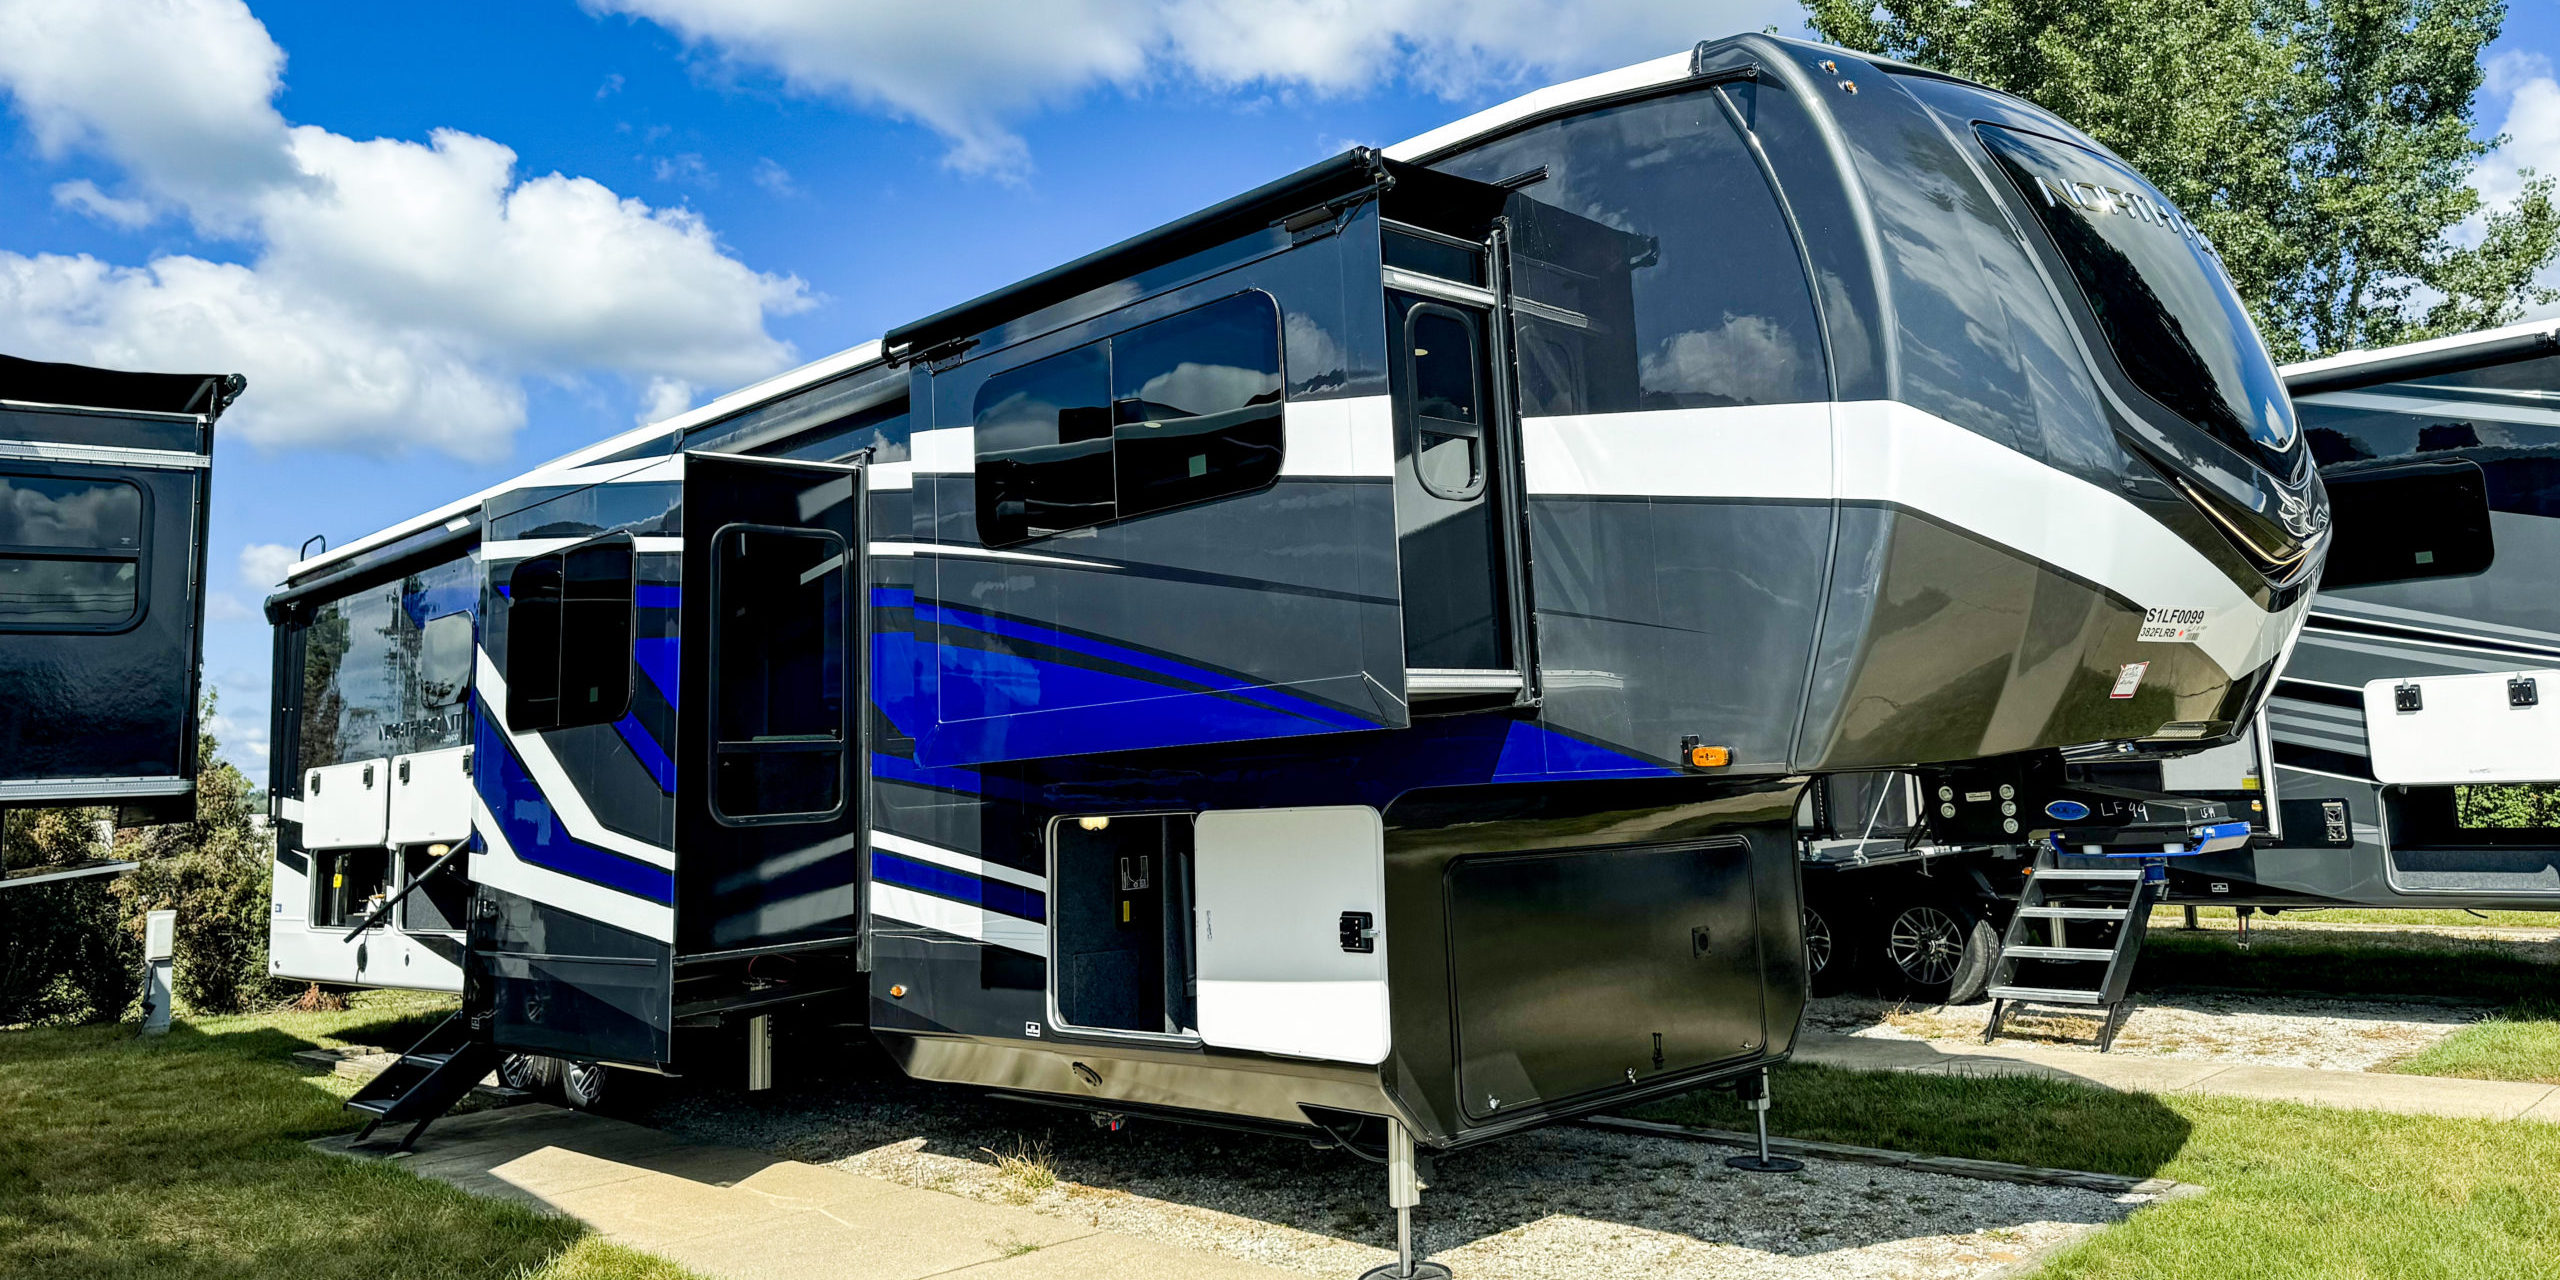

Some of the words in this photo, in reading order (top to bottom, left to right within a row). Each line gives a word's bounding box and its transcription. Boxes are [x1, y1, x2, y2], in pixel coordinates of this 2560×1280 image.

[2146, 607, 2205, 625] S1LF0099
[2140, 627, 2176, 638] 382FLRB
[2100, 802, 2123, 816] LF
[2128, 802, 2149, 821] 99
